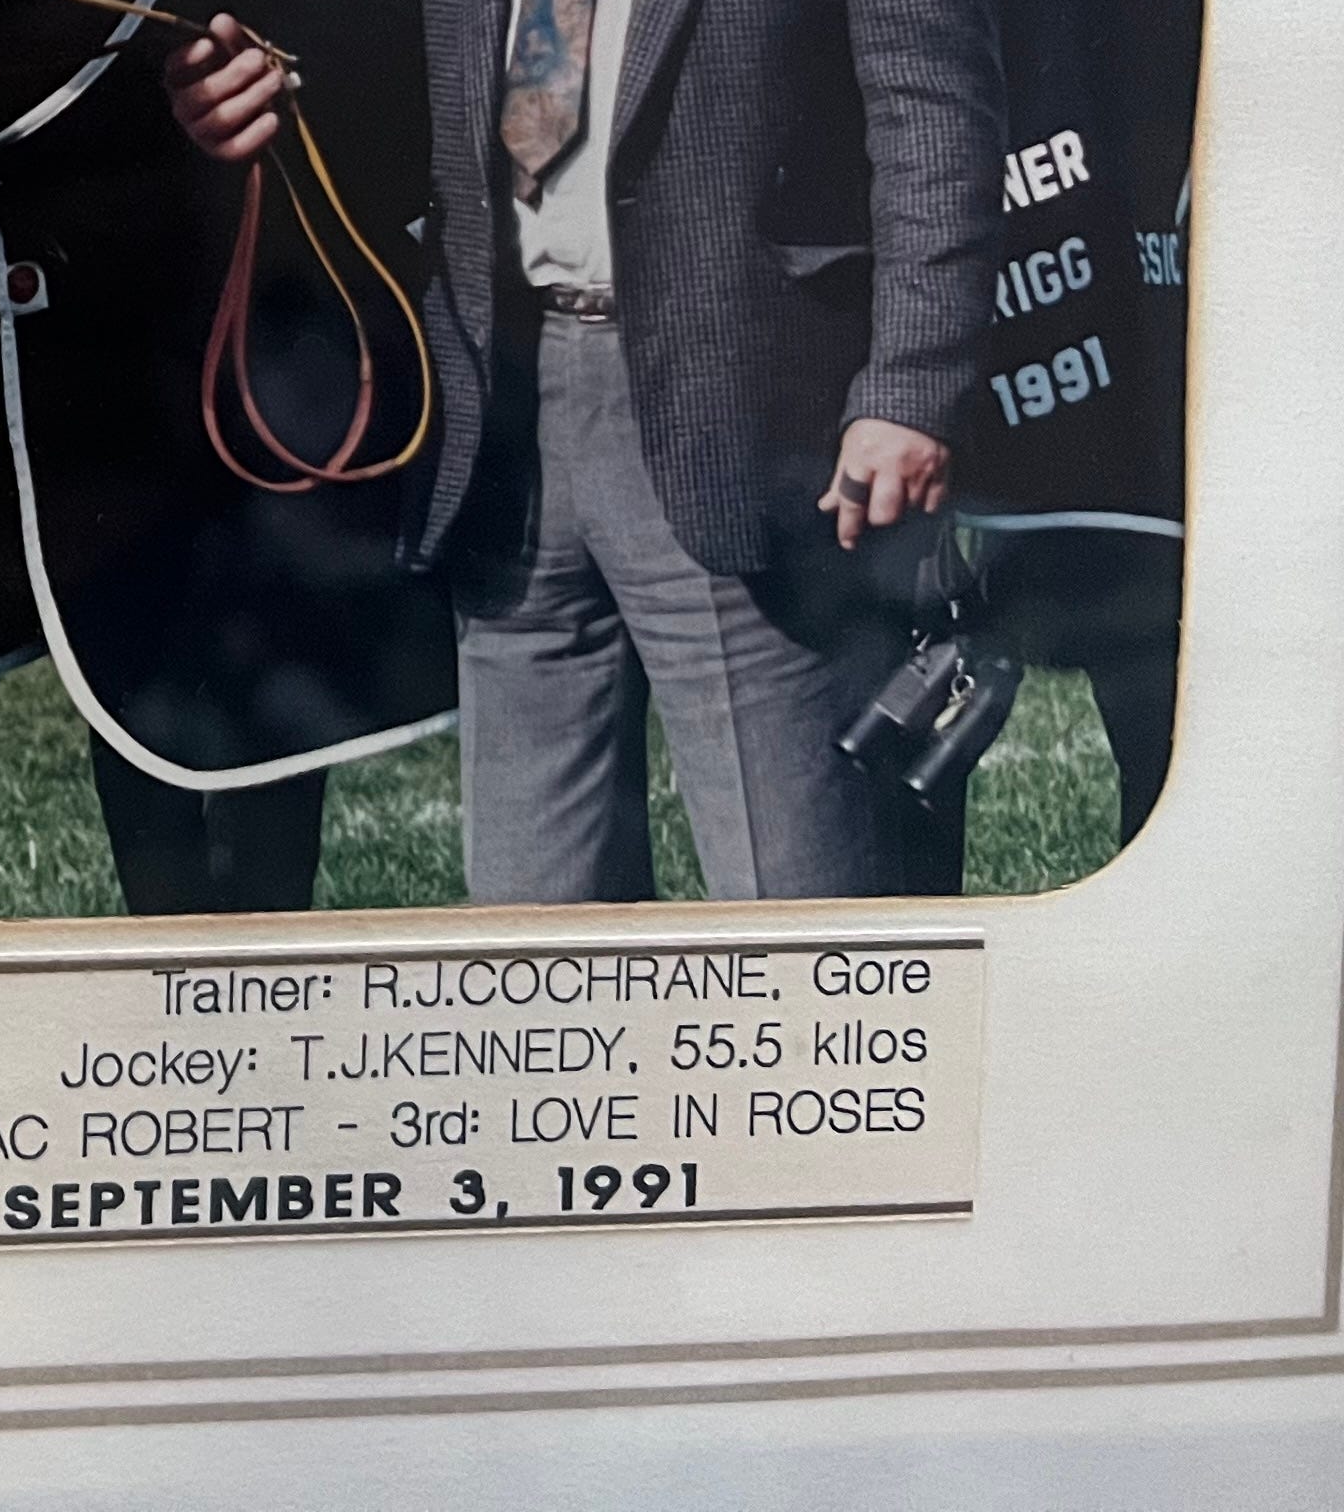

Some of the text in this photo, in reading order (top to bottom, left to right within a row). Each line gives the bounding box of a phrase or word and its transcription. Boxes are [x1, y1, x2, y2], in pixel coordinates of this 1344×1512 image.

[990, 335, 1110, 425] 1991
[152, 968, 333, 1016] Trainer:
[813, 951, 931, 997] Gore
[60, 1040, 257, 1096] Jockey:
[670, 1022, 782, 1071] 55.5
[81, 1105, 305, 1158] ROBERT
[390, 1101, 480, 1149] 3rd:
[511, 1095, 639, 1143] LOVE
[673, 1092, 718, 1139] IN
[748, 1086, 926, 1137] ROSES
[3, 1172, 402, 1231] SEPTEMBER
[449, 1169, 509, 1219] 3,
[557, 1162, 698, 1212] 1991
